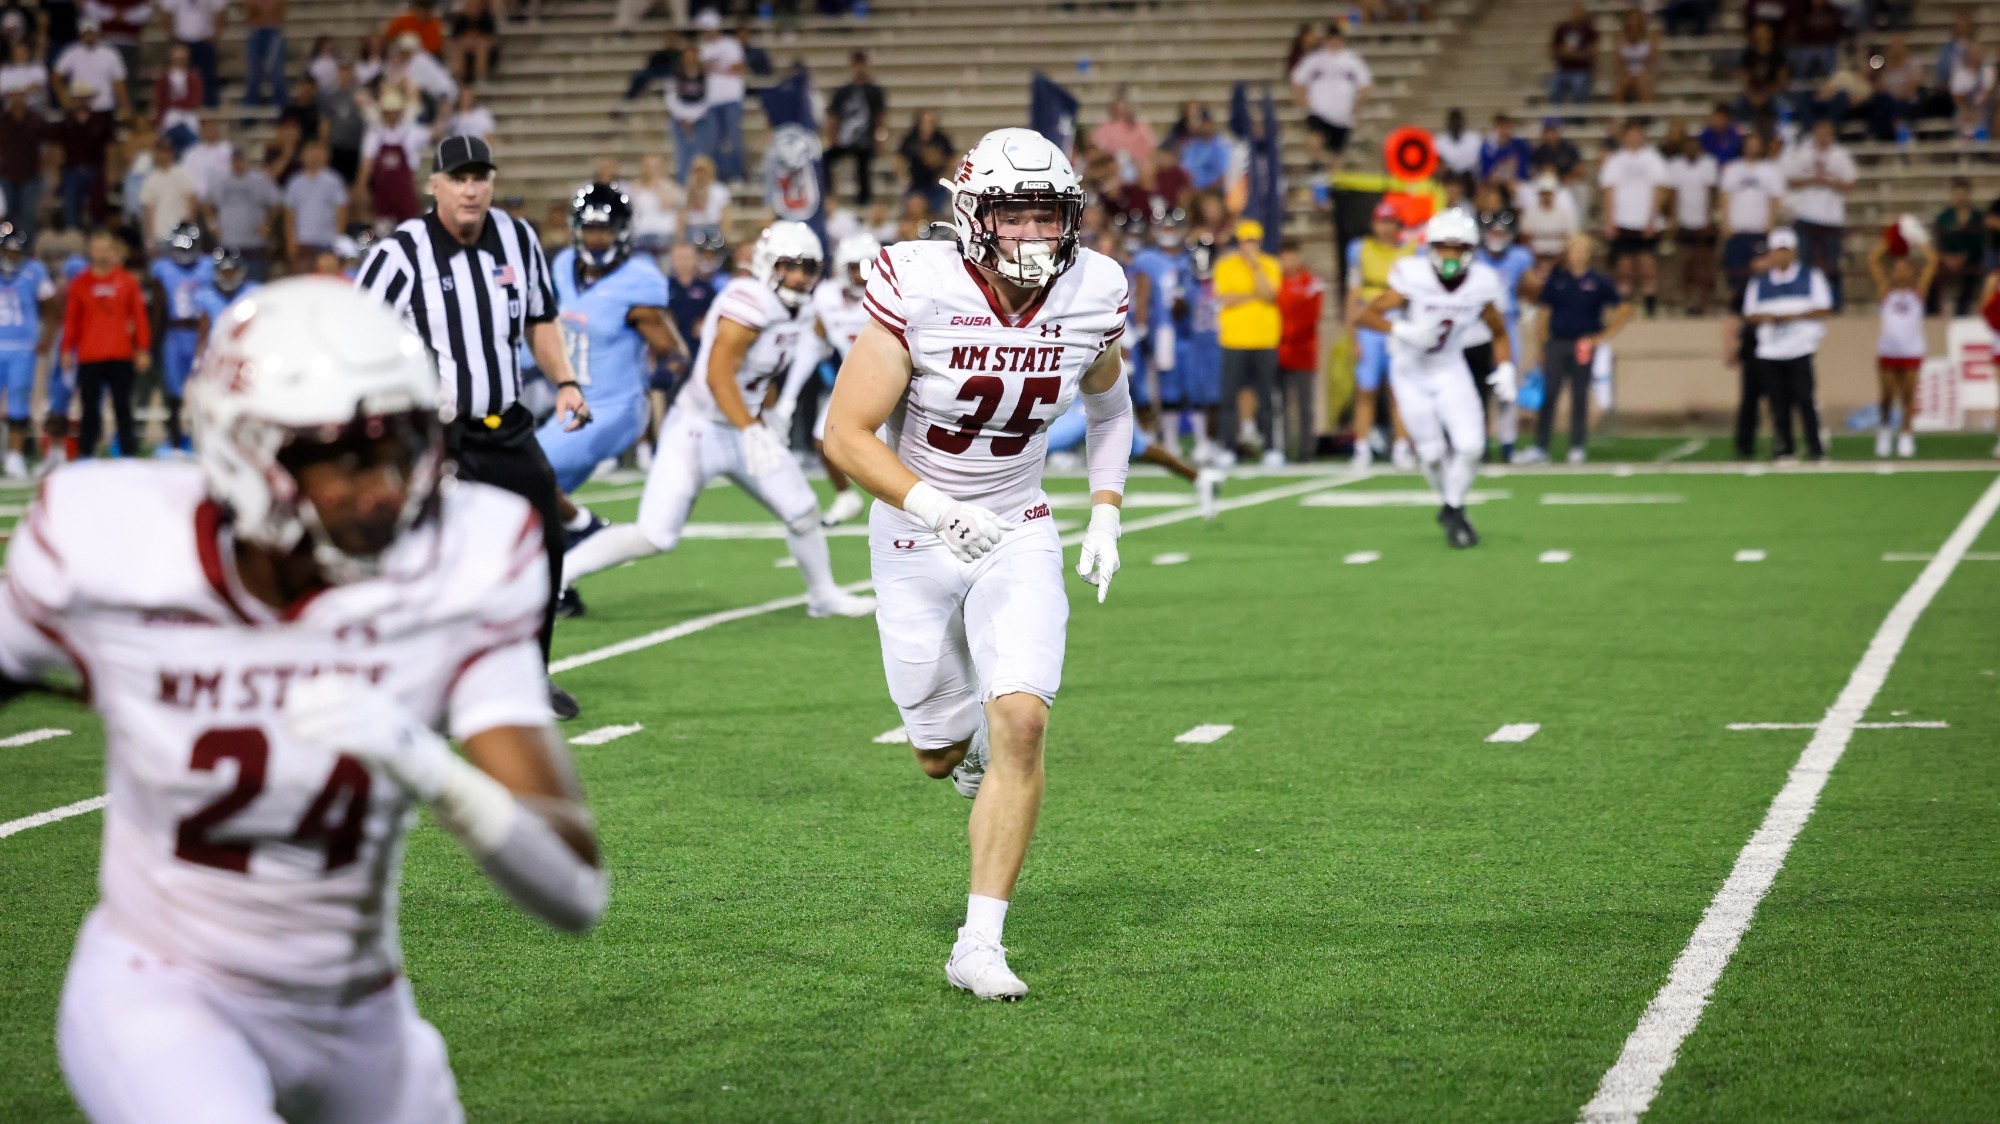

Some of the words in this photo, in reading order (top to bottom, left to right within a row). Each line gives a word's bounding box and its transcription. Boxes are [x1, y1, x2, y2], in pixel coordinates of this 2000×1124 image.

[1021, 181, 1050, 190] AGGIES
[442, 276, 454, 292] S
[508, 300, 520, 319] U
[949, 345, 990, 371] NM
[991, 346, 1065, 373] STATE
[927, 375, 1062, 457] 35
[157, 667, 224, 710] NM
[174, 727, 372, 874] 24
